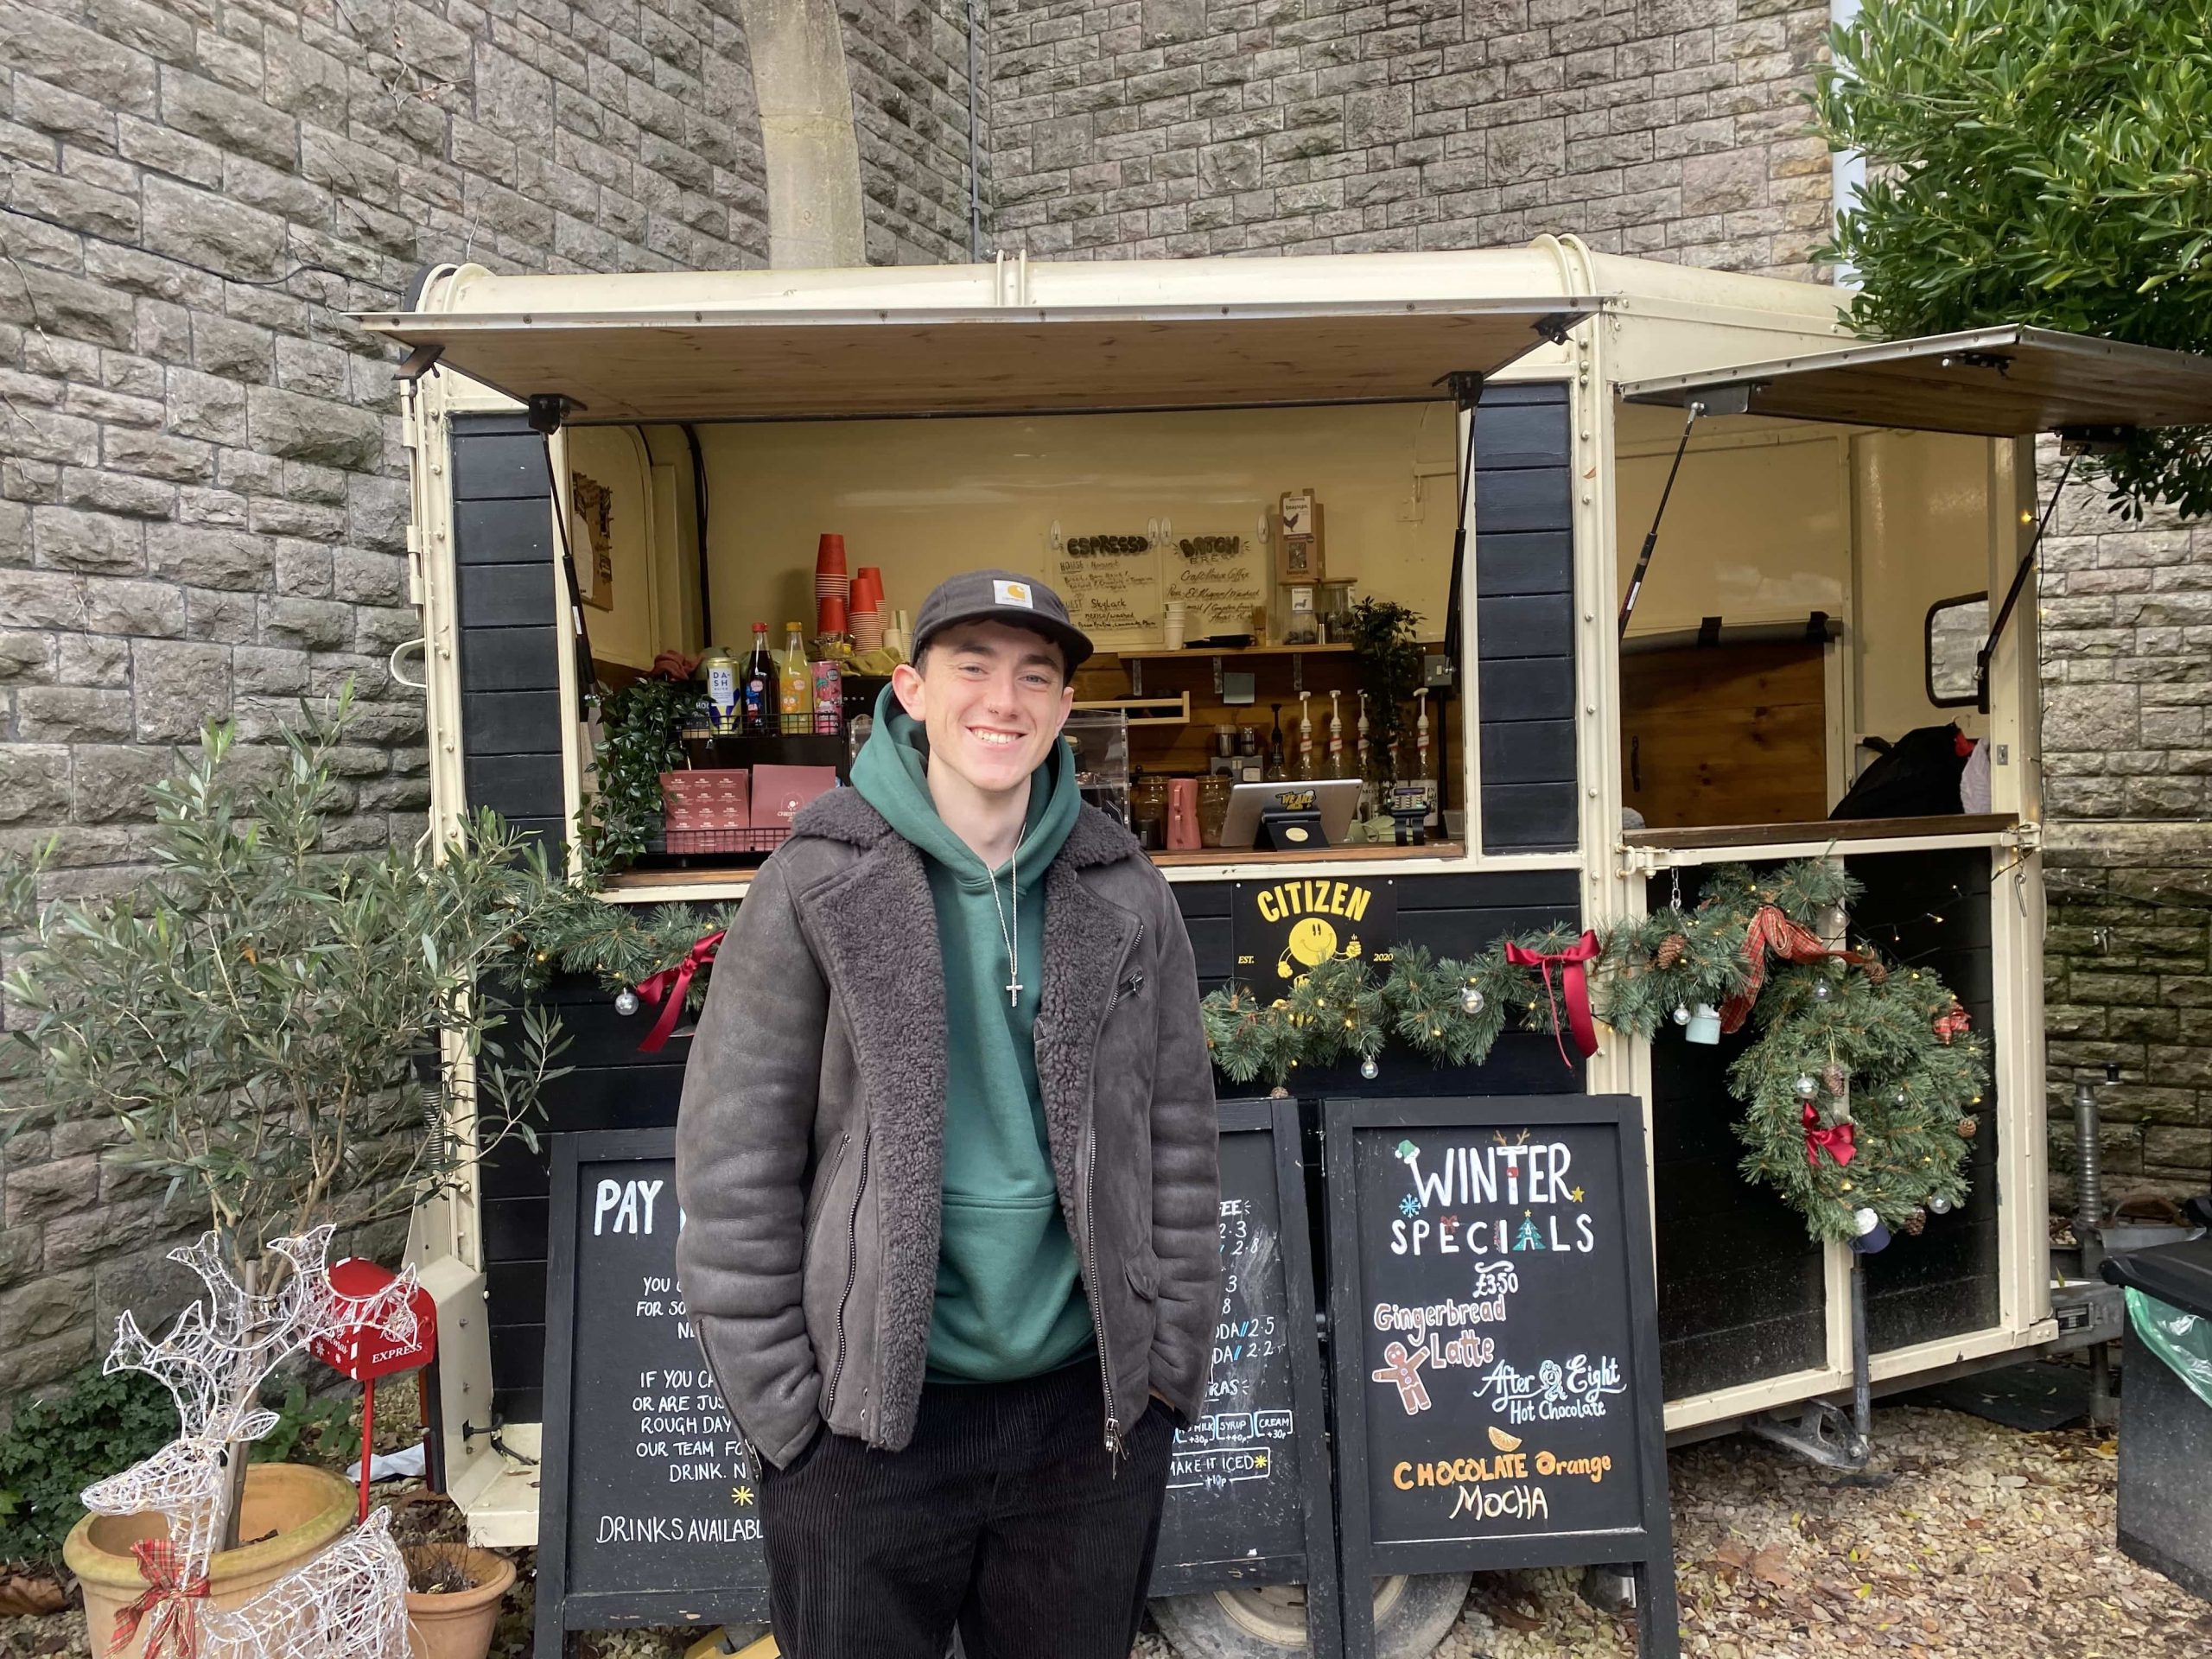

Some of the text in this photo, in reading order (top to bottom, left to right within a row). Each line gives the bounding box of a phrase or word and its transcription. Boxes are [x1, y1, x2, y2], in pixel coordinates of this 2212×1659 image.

[1067, 535, 1149, 557] ESPRESSO
[1179, 536, 1240, 557] BATCH
[1190, 553, 1235, 564] BREW
[1257, 880, 1372, 923] CITIZEN
[1238, 956, 1254, 964] EST.
[1374, 953, 1393, 962] 2020
[1404, 1142, 1575, 1207] WINTER
[594, 1179, 664, 1236] PAY
[1390, 1213, 1594, 1255] SPECIALS
[643, 1276, 671, 1296] YOU
[636, 1300, 664, 1317] FOR
[1373, 1294, 1507, 1346] Gingerbread
[372, 1342, 423, 1364] EXPRESS
[1429, 1329, 1495, 1370] Latte
[639, 1370, 658, 1389] IF
[663, 1370, 693, 1389] YOU
[1473, 1353, 1627, 1413] After Eight
[632, 1395, 655, 1412] OR
[658, 1395, 690, 1413] ARE
[1510, 1398, 1606, 1425] Hot Chocolate
[640, 1415, 733, 1436] ROUGH DAY
[1219, 1420, 1247, 1431] SYRUP
[1258, 1417, 1290, 1428] CREAM
[635, 1440, 669, 1458] OUR
[672, 1440, 715, 1458] TEAM
[1188, 1434, 1209, 1446] +30p
[669, 1462, 727, 1483] DRINK.
[1206, 1457, 1217, 1470] IT
[1222, 1455, 1255, 1472] ICED
[1393, 1451, 1612, 1491] CHOCOLATE Orange
[1448, 1484, 1548, 1522] MOCHA
[596, 1515, 684, 1544] DRINKS
